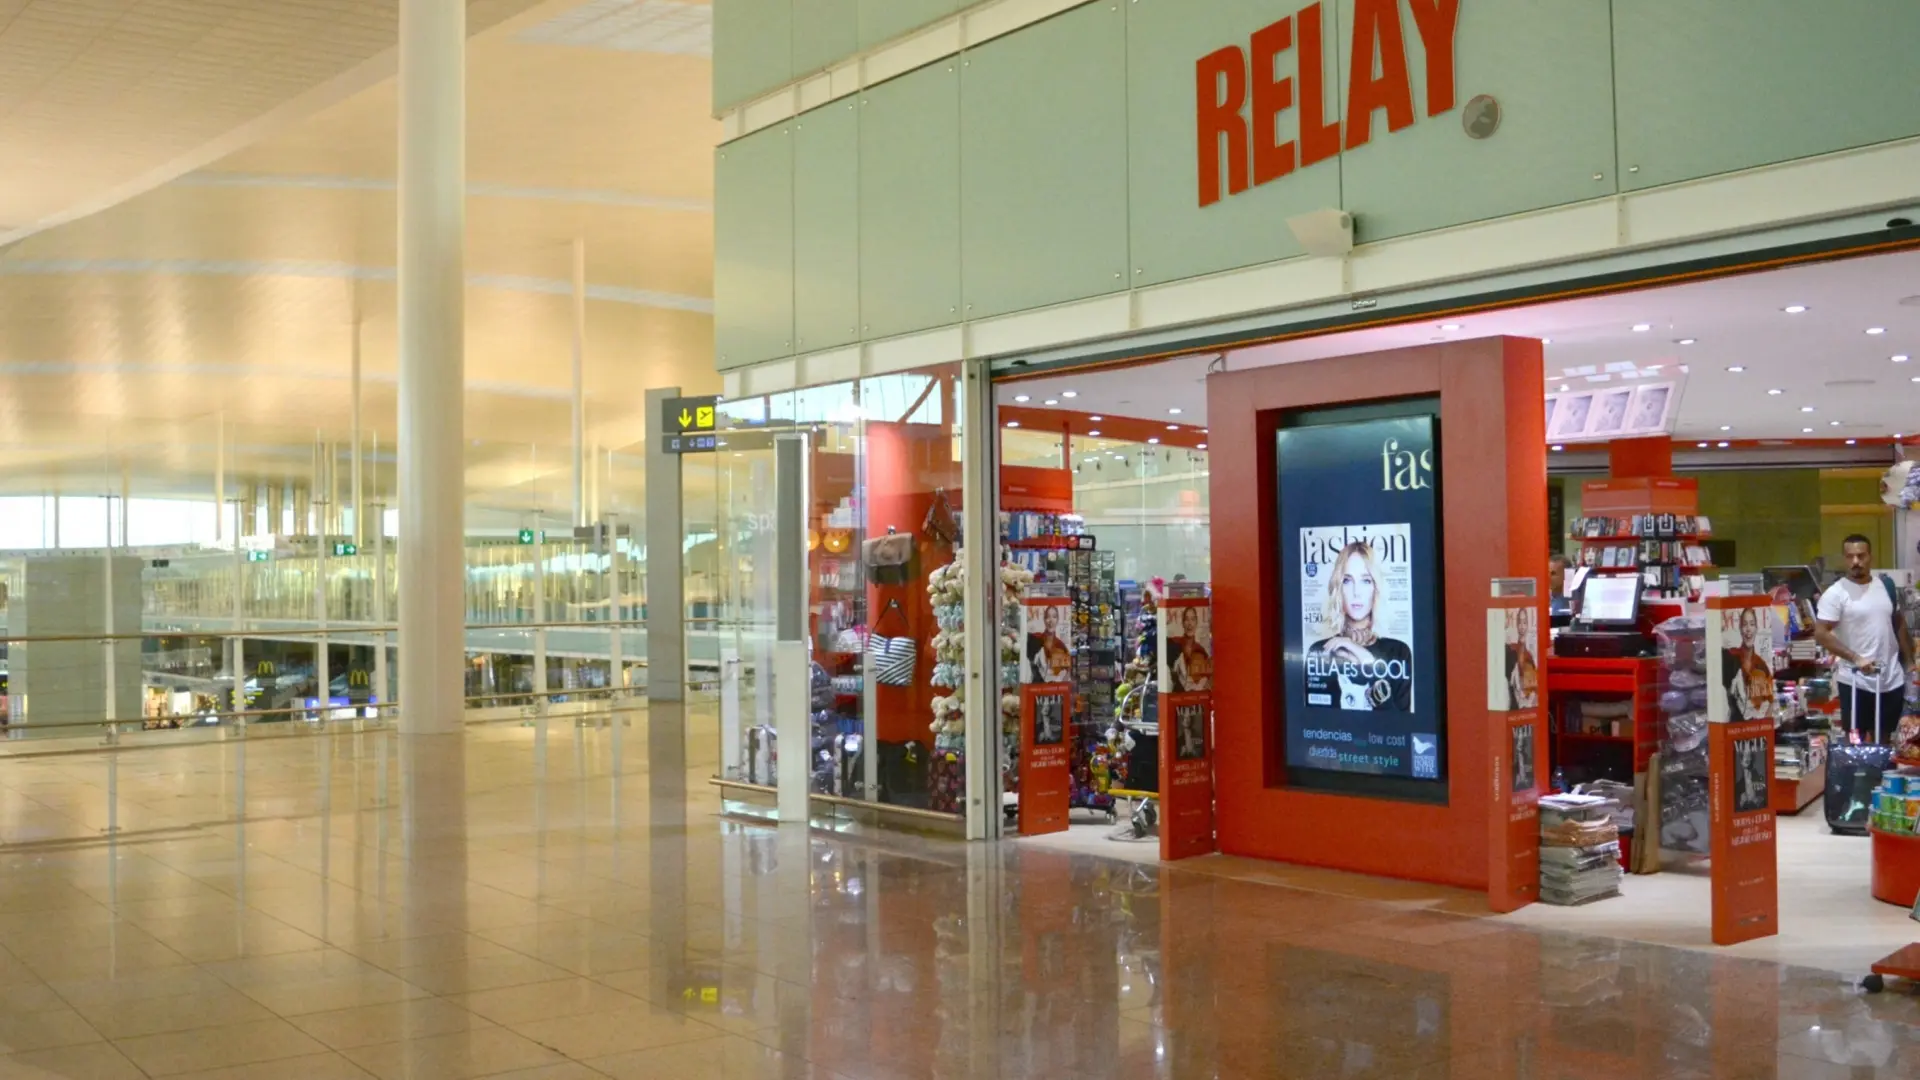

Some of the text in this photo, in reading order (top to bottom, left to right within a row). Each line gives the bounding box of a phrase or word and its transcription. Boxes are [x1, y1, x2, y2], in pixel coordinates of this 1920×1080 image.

[1196, 0, 1460, 208] RELAY
[1307, 656, 1410, 680] ELLA ES COOL
[1303, 728, 1353, 742] tendencias
[1368, 732, 1383, 745] low
[1386, 734, 1406, 747] cost
[1734, 736, 1767, 752] VOGUE
[1339, 752, 1369, 764] street
[1374, 755, 1400, 768] style
